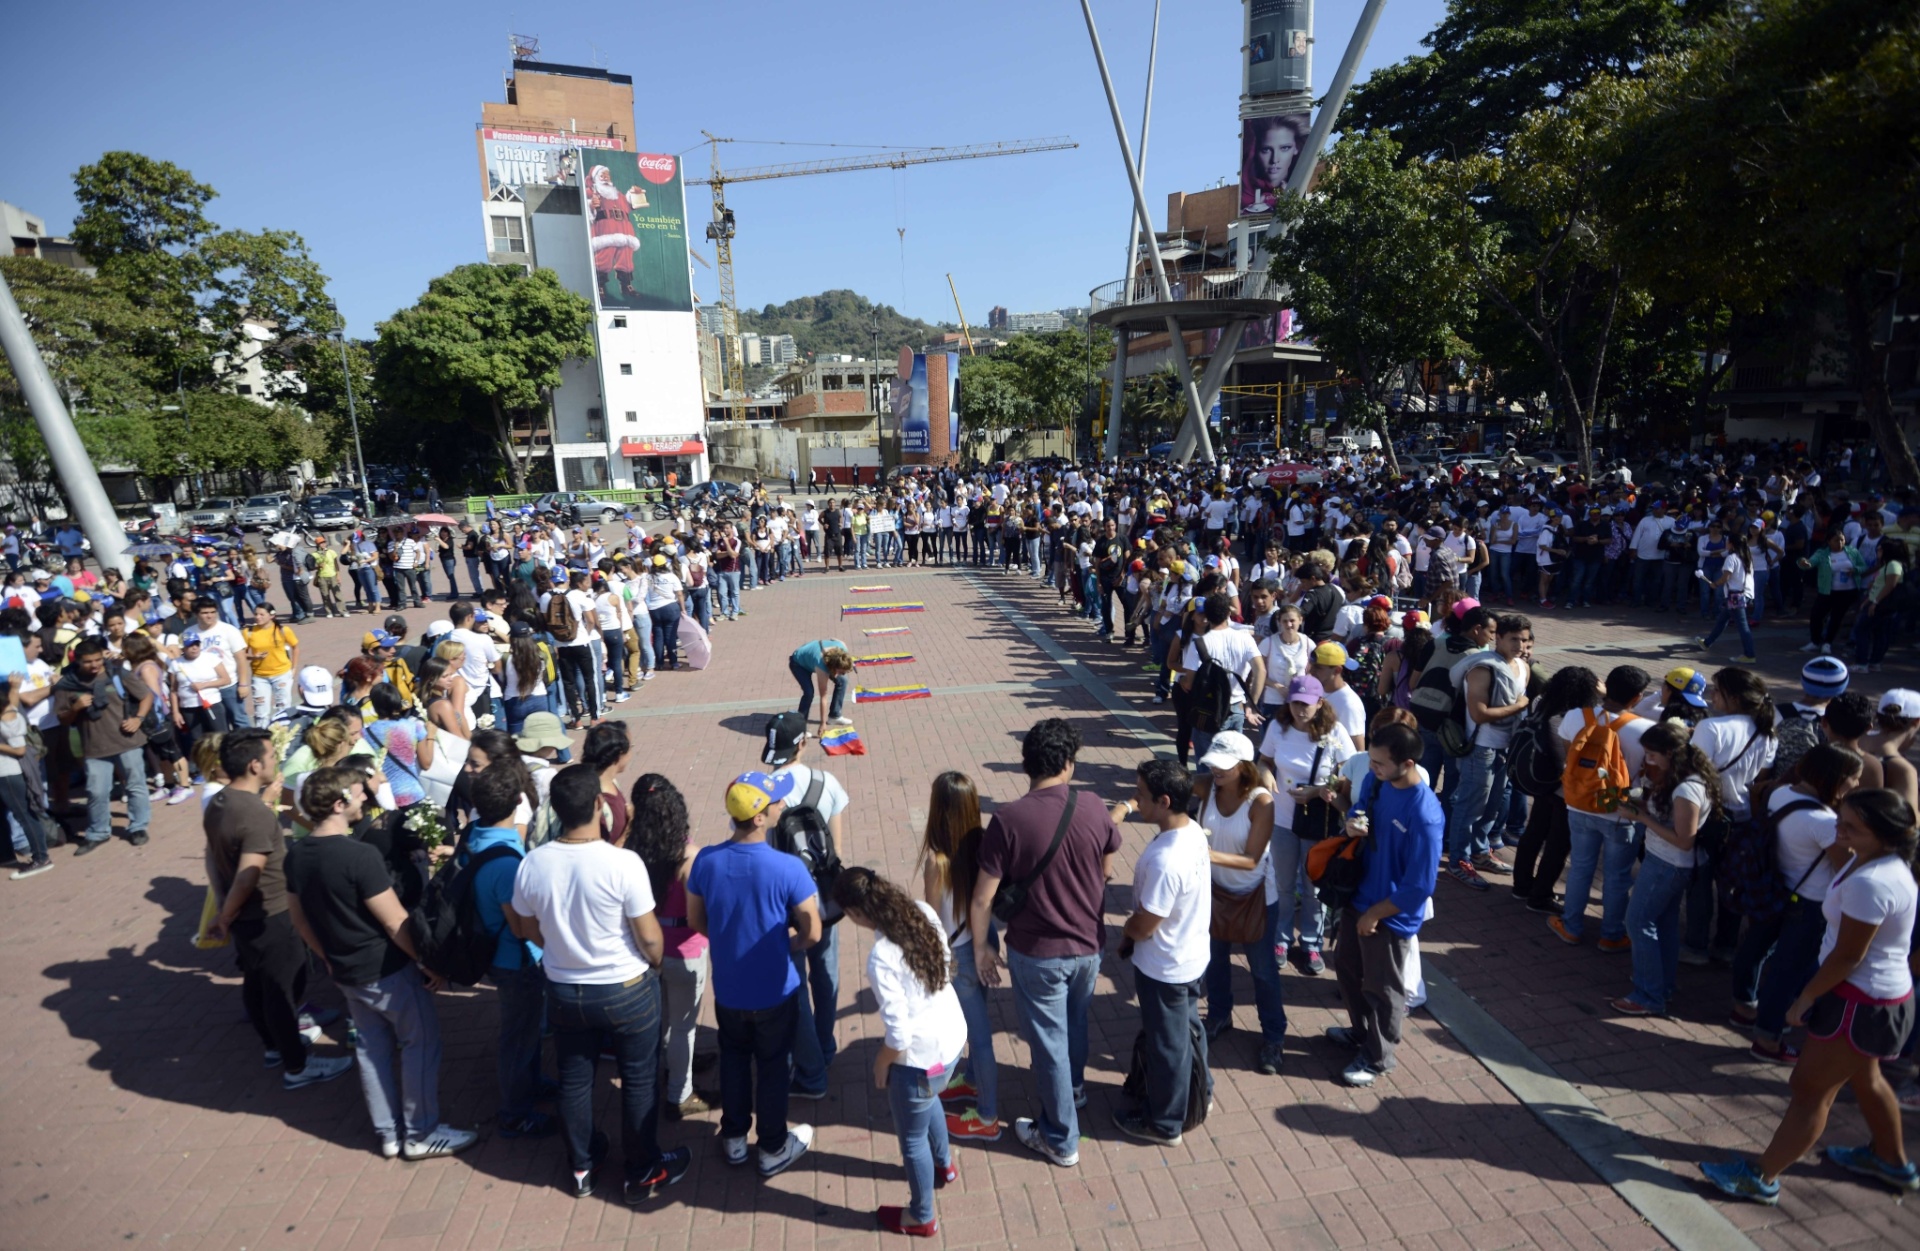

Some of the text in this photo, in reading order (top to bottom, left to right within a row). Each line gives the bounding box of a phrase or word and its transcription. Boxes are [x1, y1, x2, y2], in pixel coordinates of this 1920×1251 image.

[492, 131, 537, 142] Venezolana
[538, 135, 548, 143] de
[494, 144, 547, 162] Chávez
[638, 156, 673, 171] Coca-Cola
[496, 160, 549, 185] VIVE
[633, 213, 681, 225] Yo también
